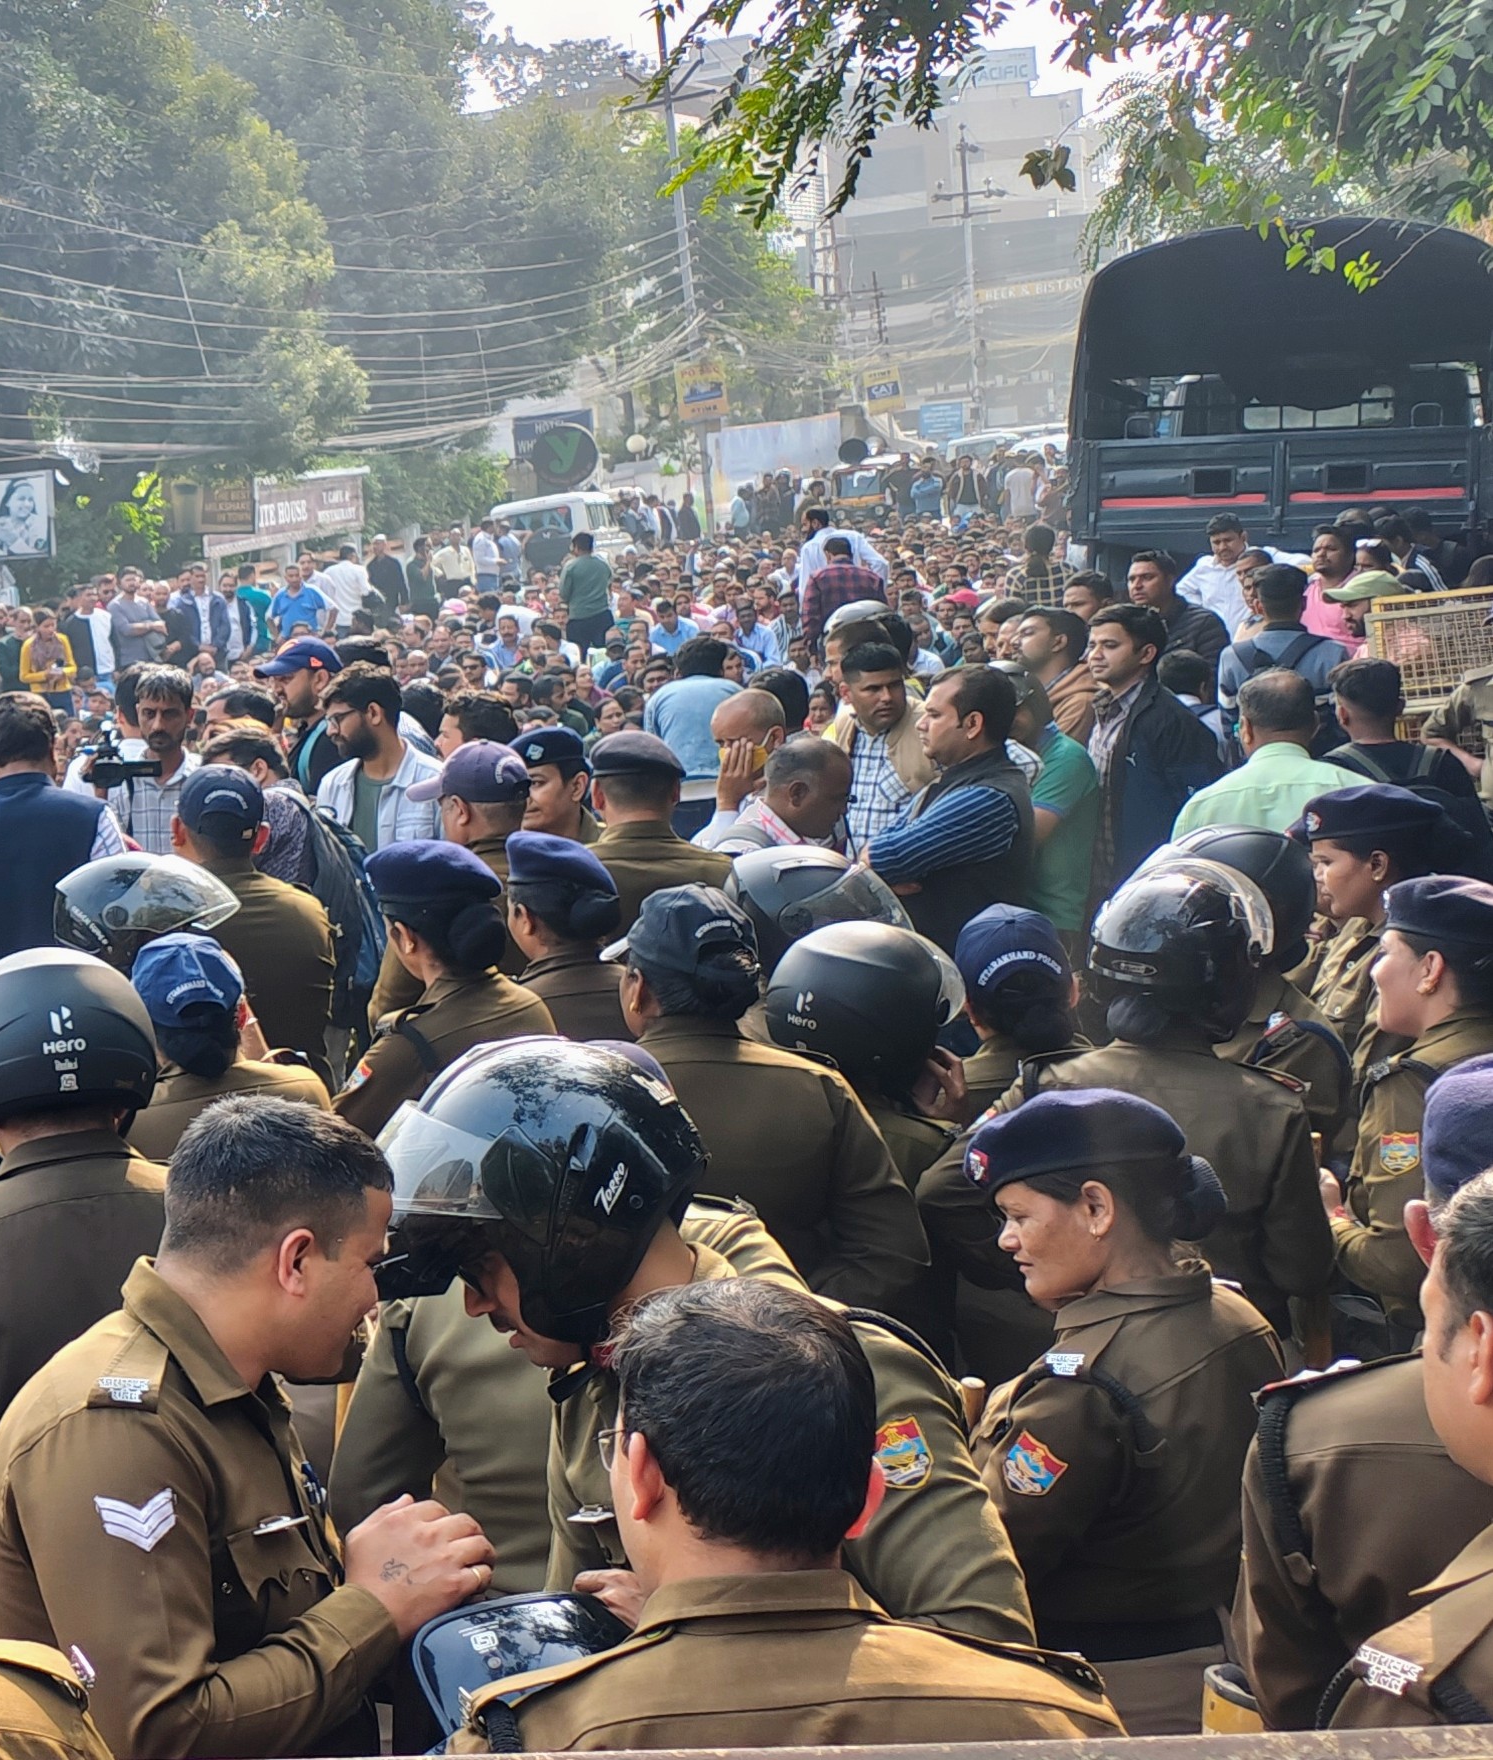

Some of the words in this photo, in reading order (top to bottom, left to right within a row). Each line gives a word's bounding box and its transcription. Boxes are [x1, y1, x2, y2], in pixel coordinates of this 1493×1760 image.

[976, 64, 1028, 81] ACIFIC
[871, 382, 894, 394] CAT
[278, 499, 307, 526] HOUSE
[978, 951, 1036, 987] UTTARAKHAND
